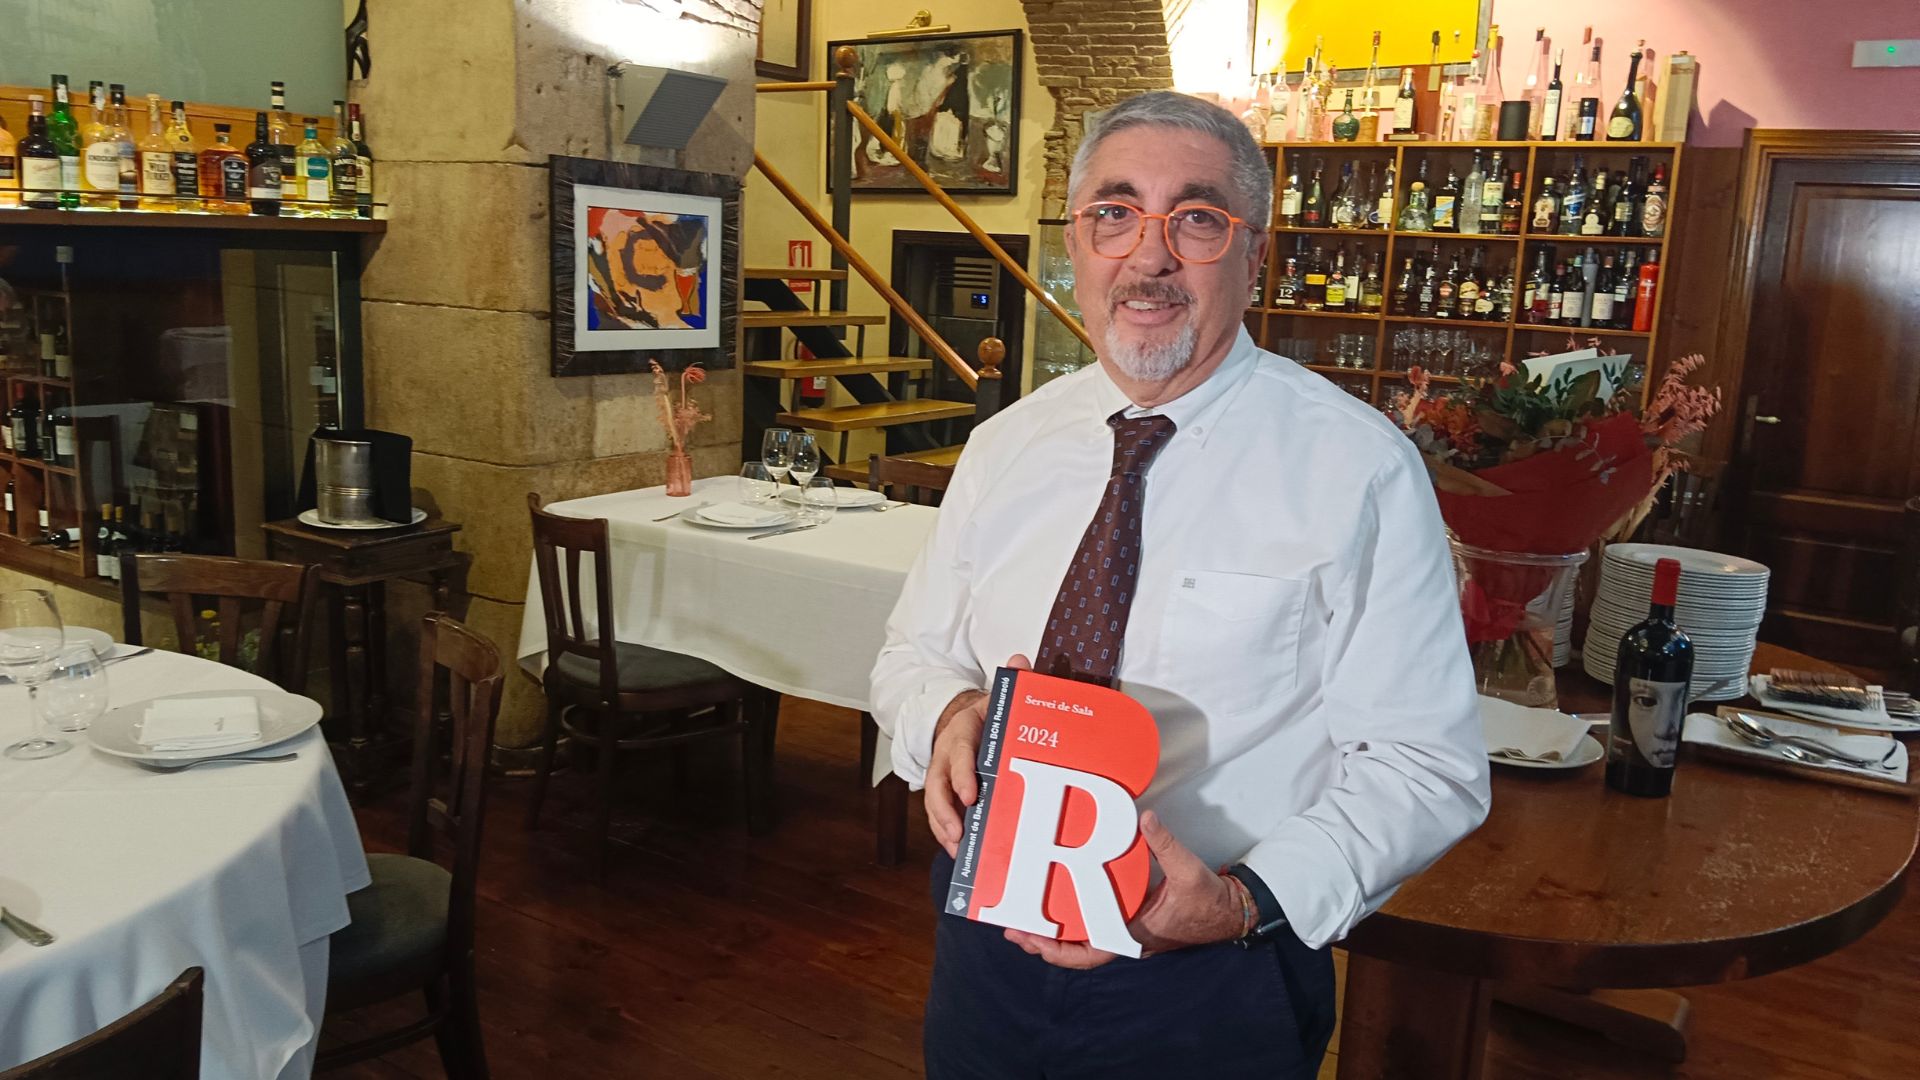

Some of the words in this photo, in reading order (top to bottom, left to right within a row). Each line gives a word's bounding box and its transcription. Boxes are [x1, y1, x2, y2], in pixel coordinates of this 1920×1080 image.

[1279, 288, 1293, 298] 12
[993, 676, 1010, 721] Restauració
[1024, 694, 1057, 709] Servei
[1057, 701, 1071, 712] de
[1071, 704, 1094, 717] Sala
[989, 721, 1001, 740] BCN
[1017, 724, 1059, 748] 2024
[983, 740, 997, 767] Premis
[960, 832, 978, 878] Ajuntament
[970, 820, 981, 832] de
[977, 756, 1143, 960] R
